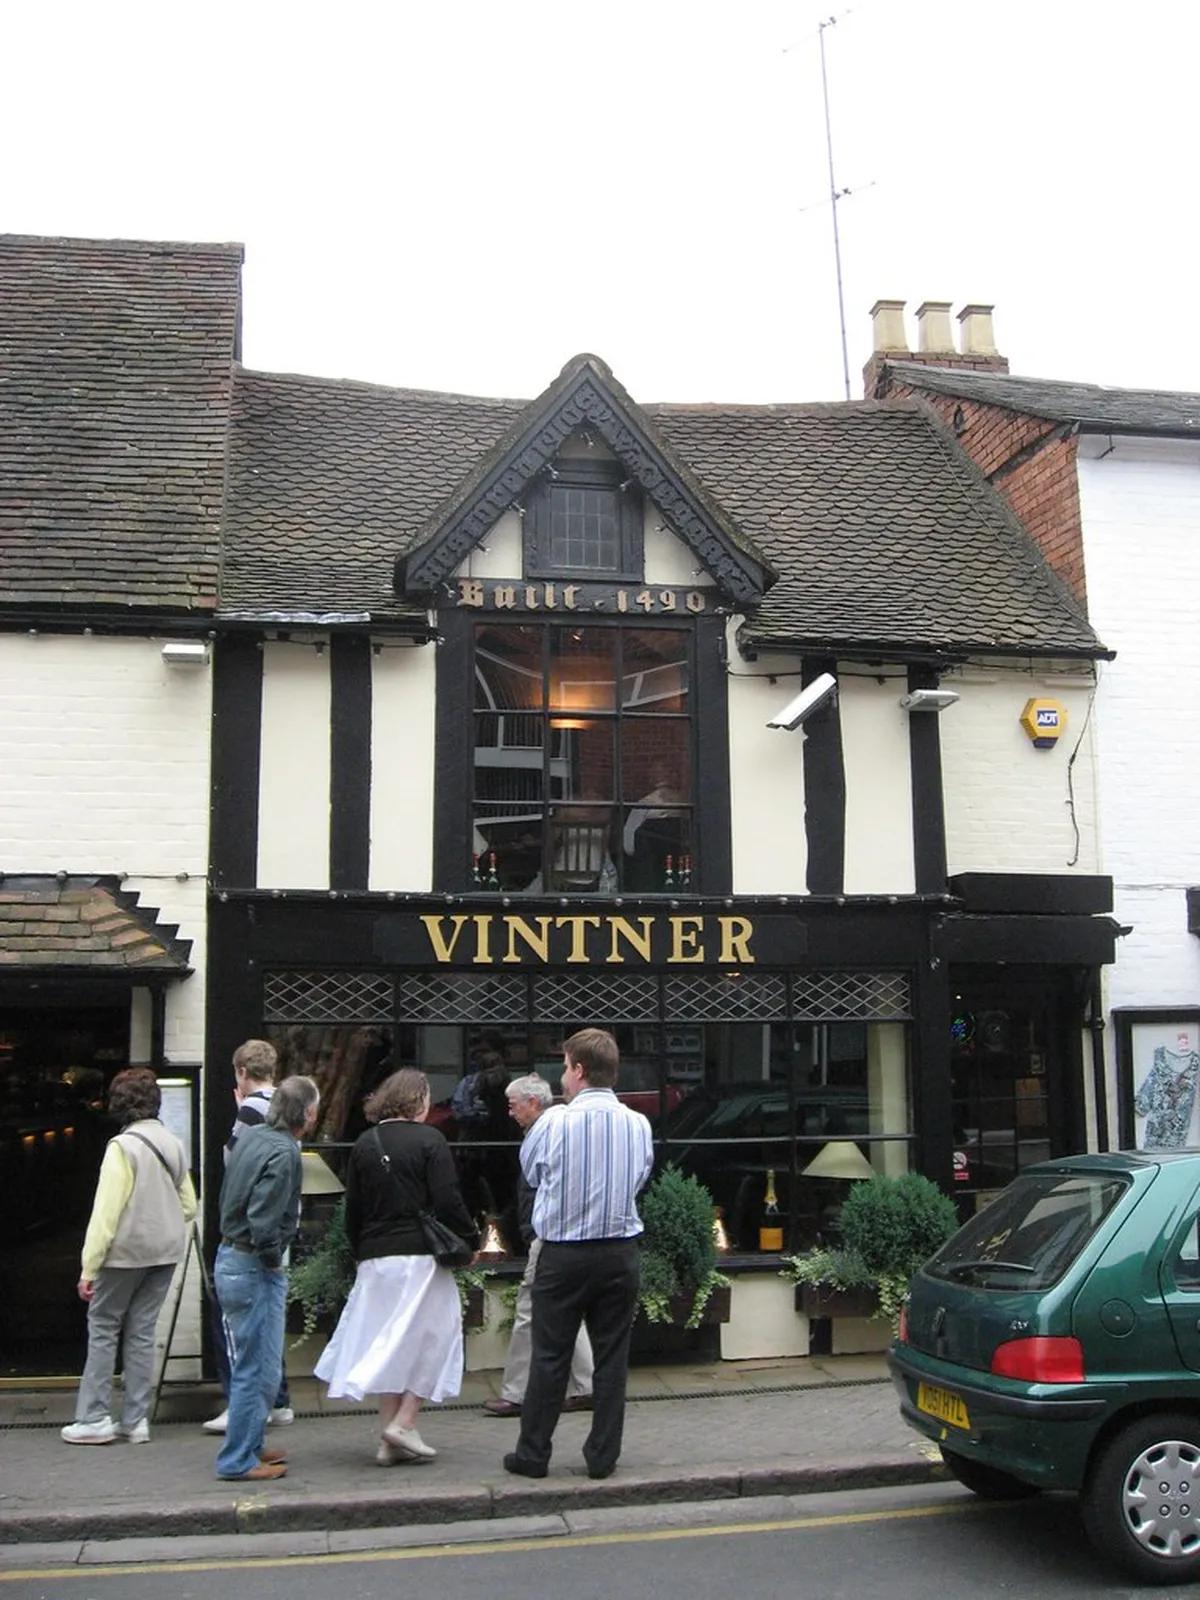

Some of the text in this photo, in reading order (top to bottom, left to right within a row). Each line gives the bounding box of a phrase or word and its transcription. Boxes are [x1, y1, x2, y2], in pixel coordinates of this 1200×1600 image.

[457, 579, 706, 613] Built 1490
[1038, 711, 1057, 724] ADT
[419, 914, 756, 964] VINTNER
